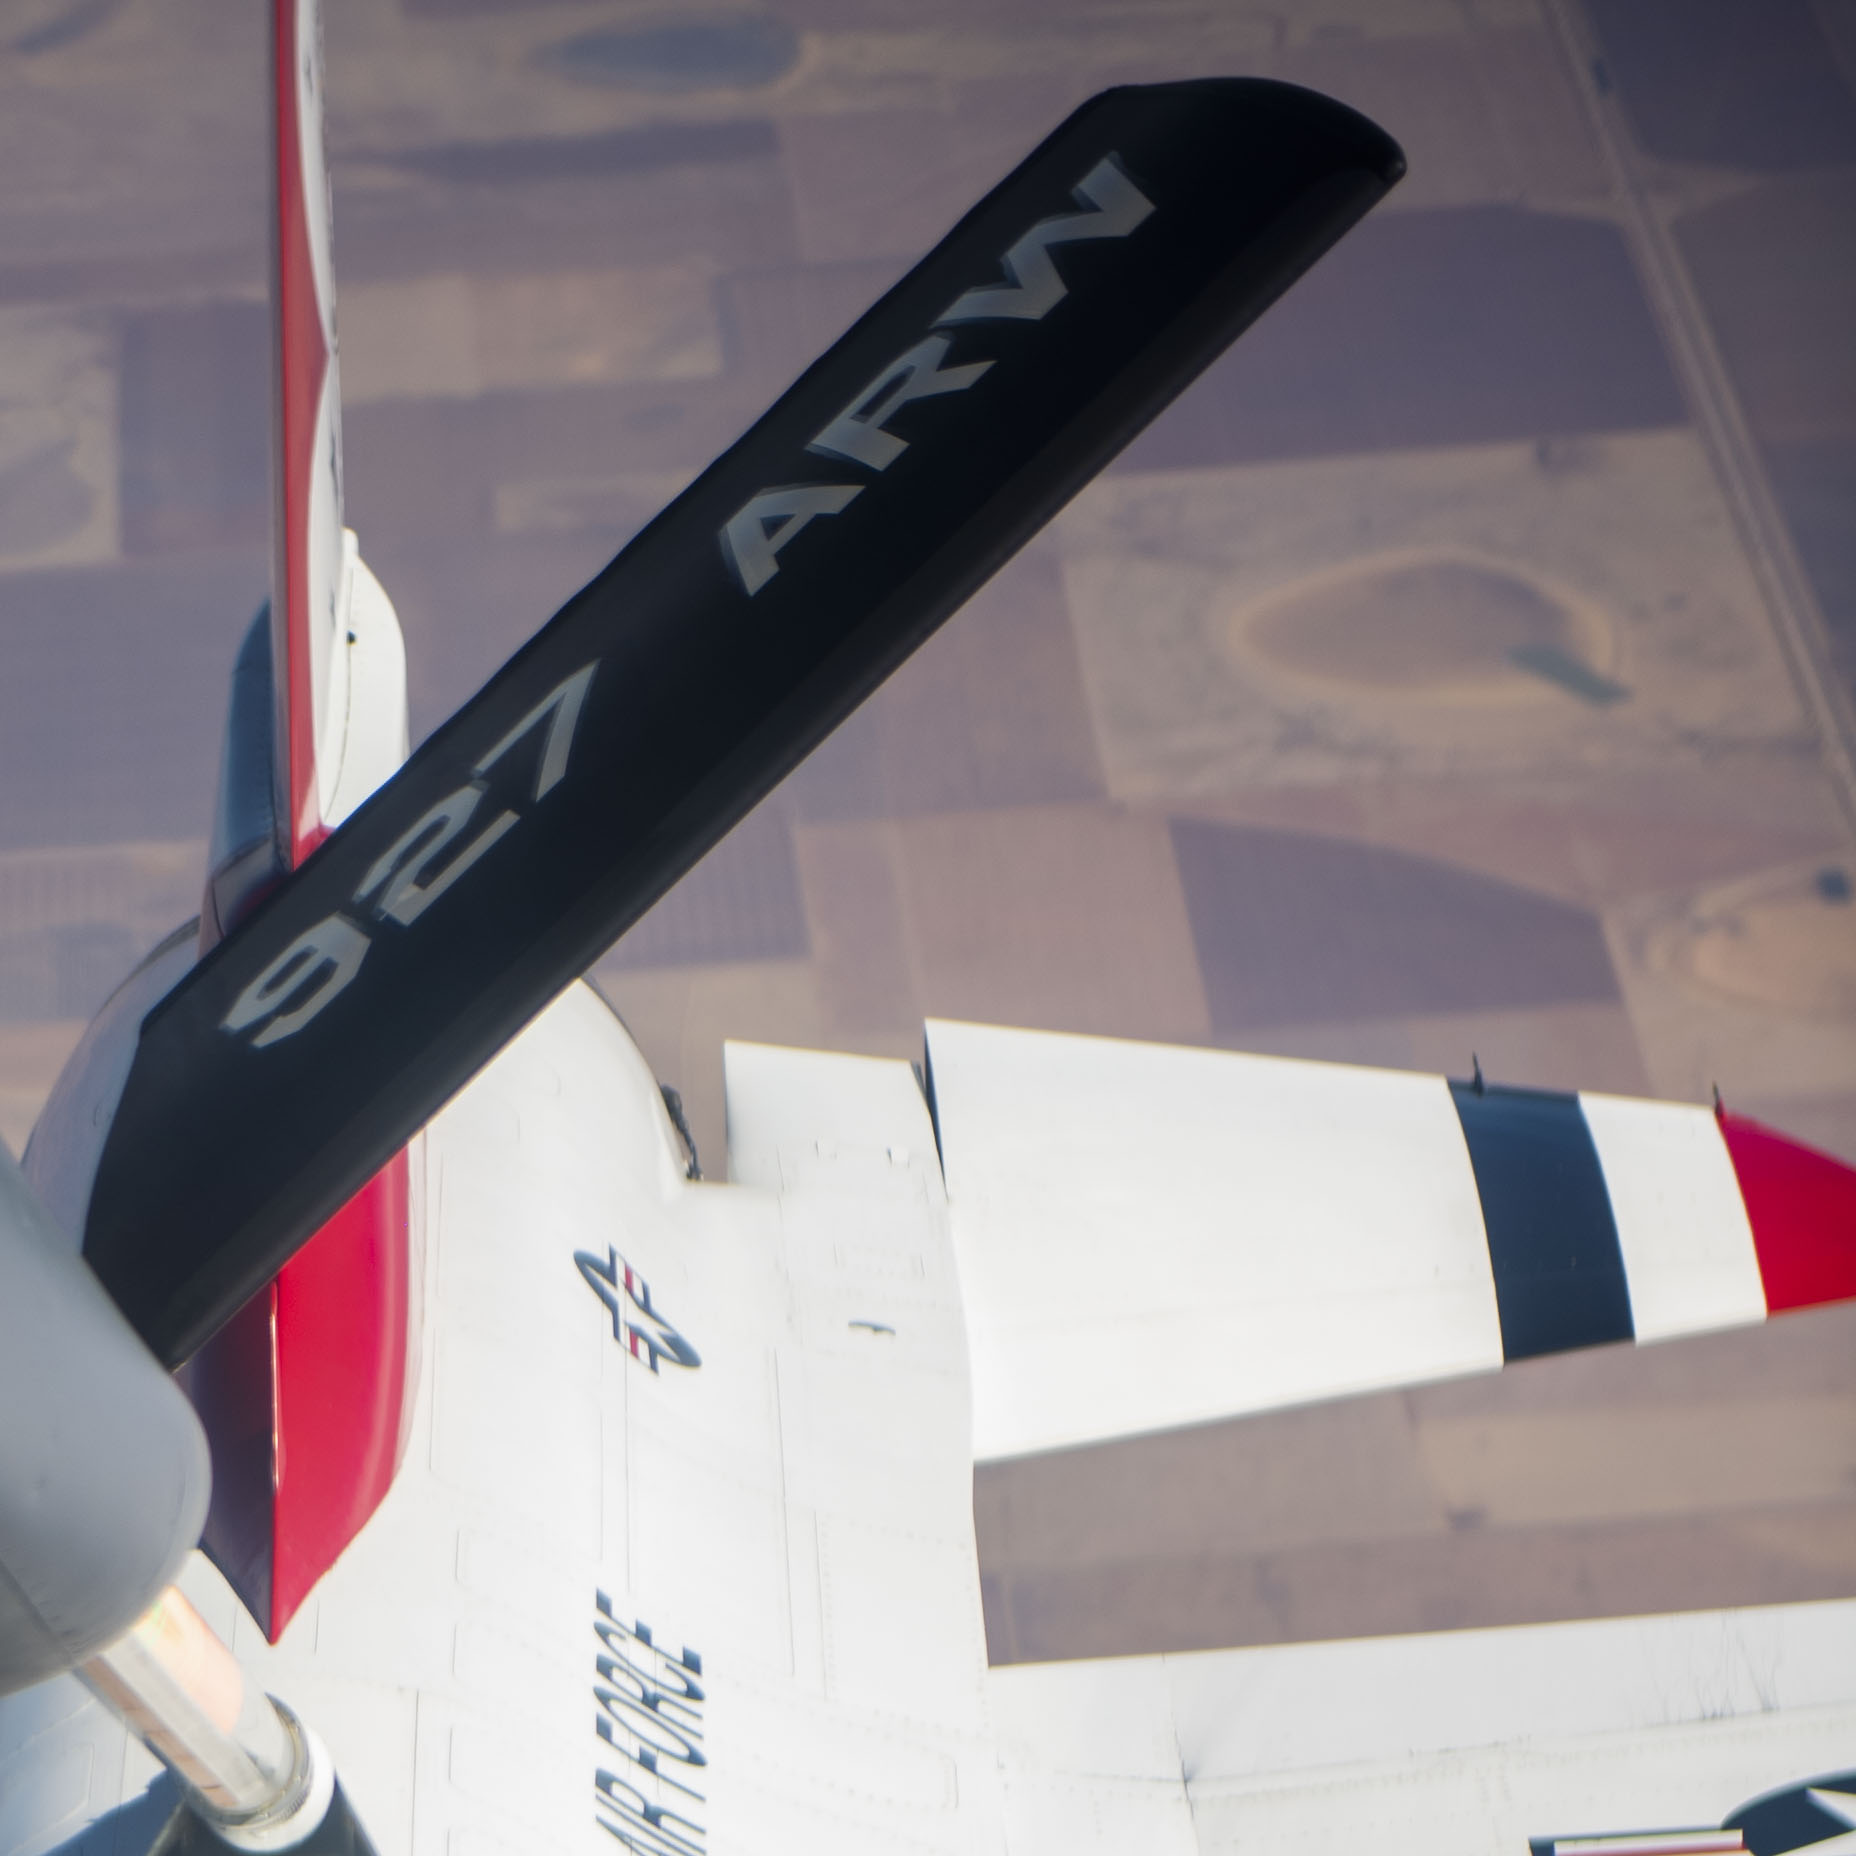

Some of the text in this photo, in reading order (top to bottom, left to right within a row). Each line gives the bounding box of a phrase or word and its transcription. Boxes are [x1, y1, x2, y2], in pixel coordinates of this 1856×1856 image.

[216, 150, 1157, 1050] 927 ARW
[593, 1587, 707, 1803] FORCE
